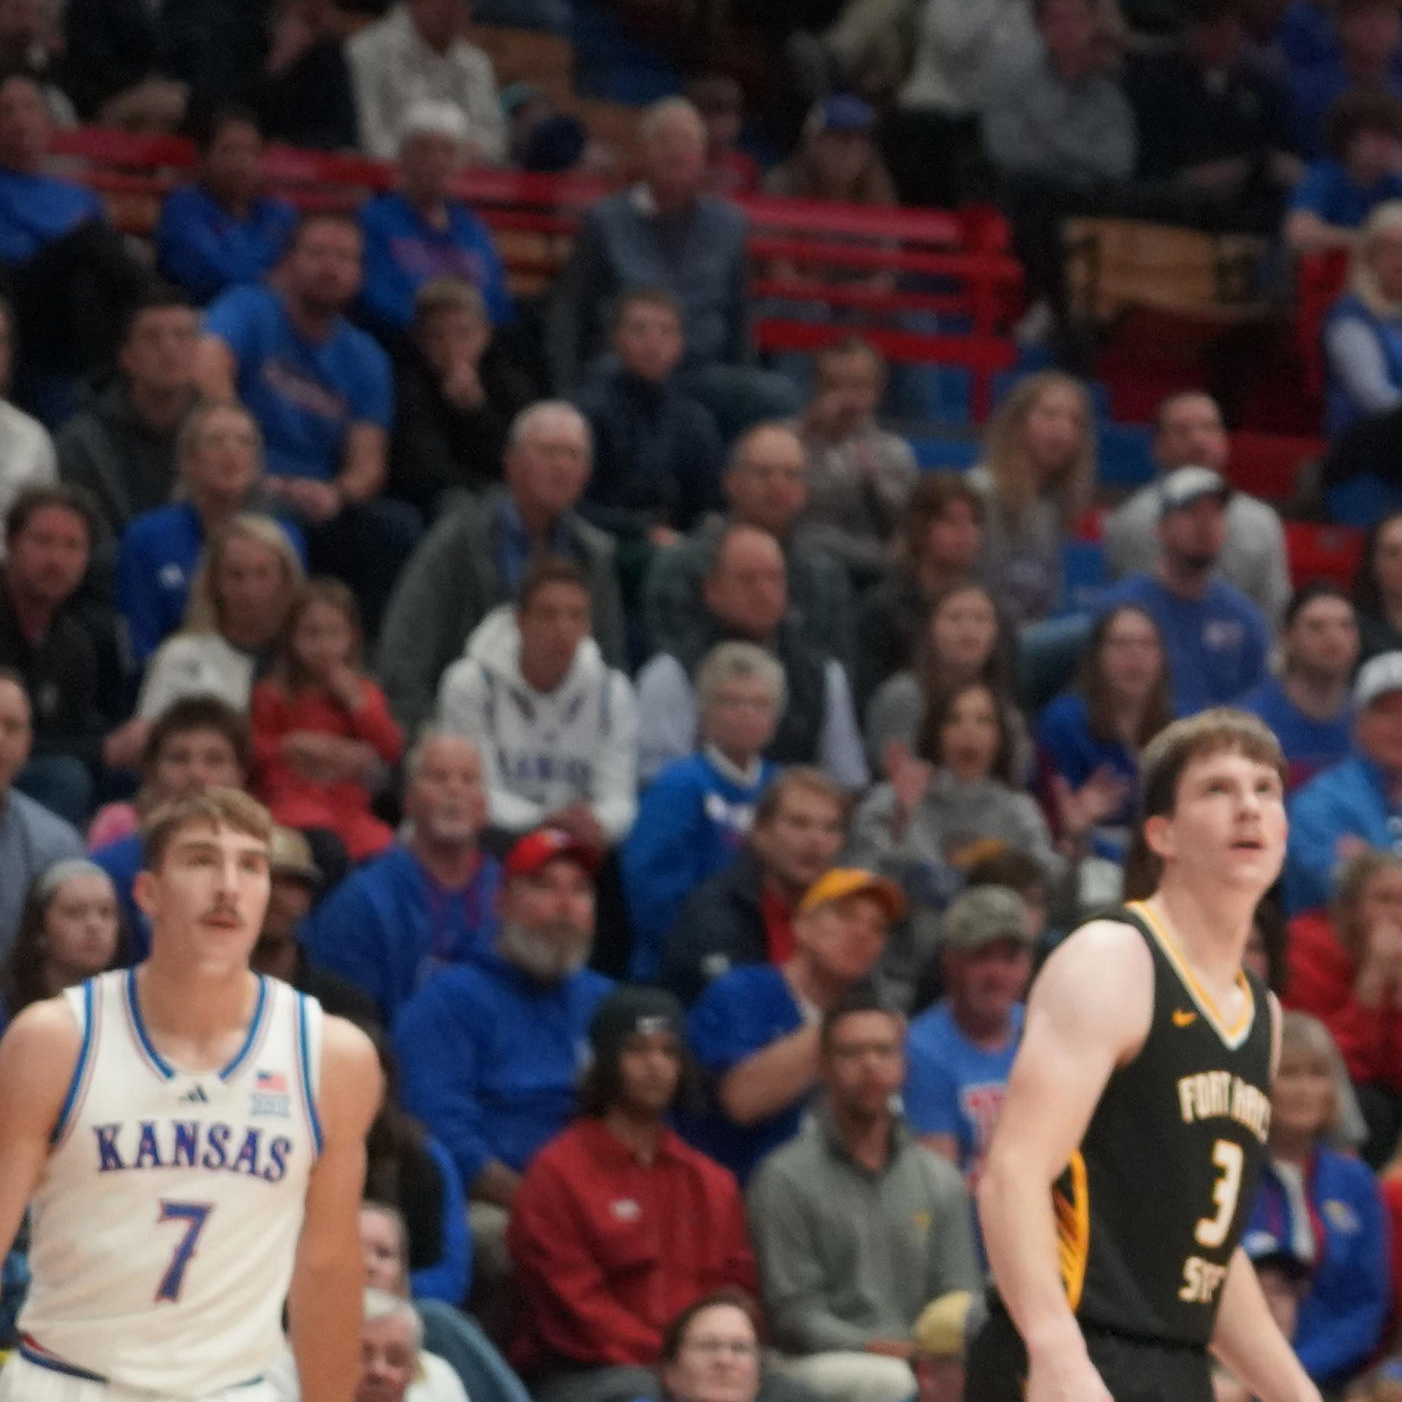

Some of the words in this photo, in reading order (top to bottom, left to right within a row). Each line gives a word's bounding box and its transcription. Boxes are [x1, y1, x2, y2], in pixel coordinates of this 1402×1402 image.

[93, 1120, 293, 1184] KANSAS
[1194, 1139, 1244, 1247] 3
[155, 1198, 215, 1303] 7
